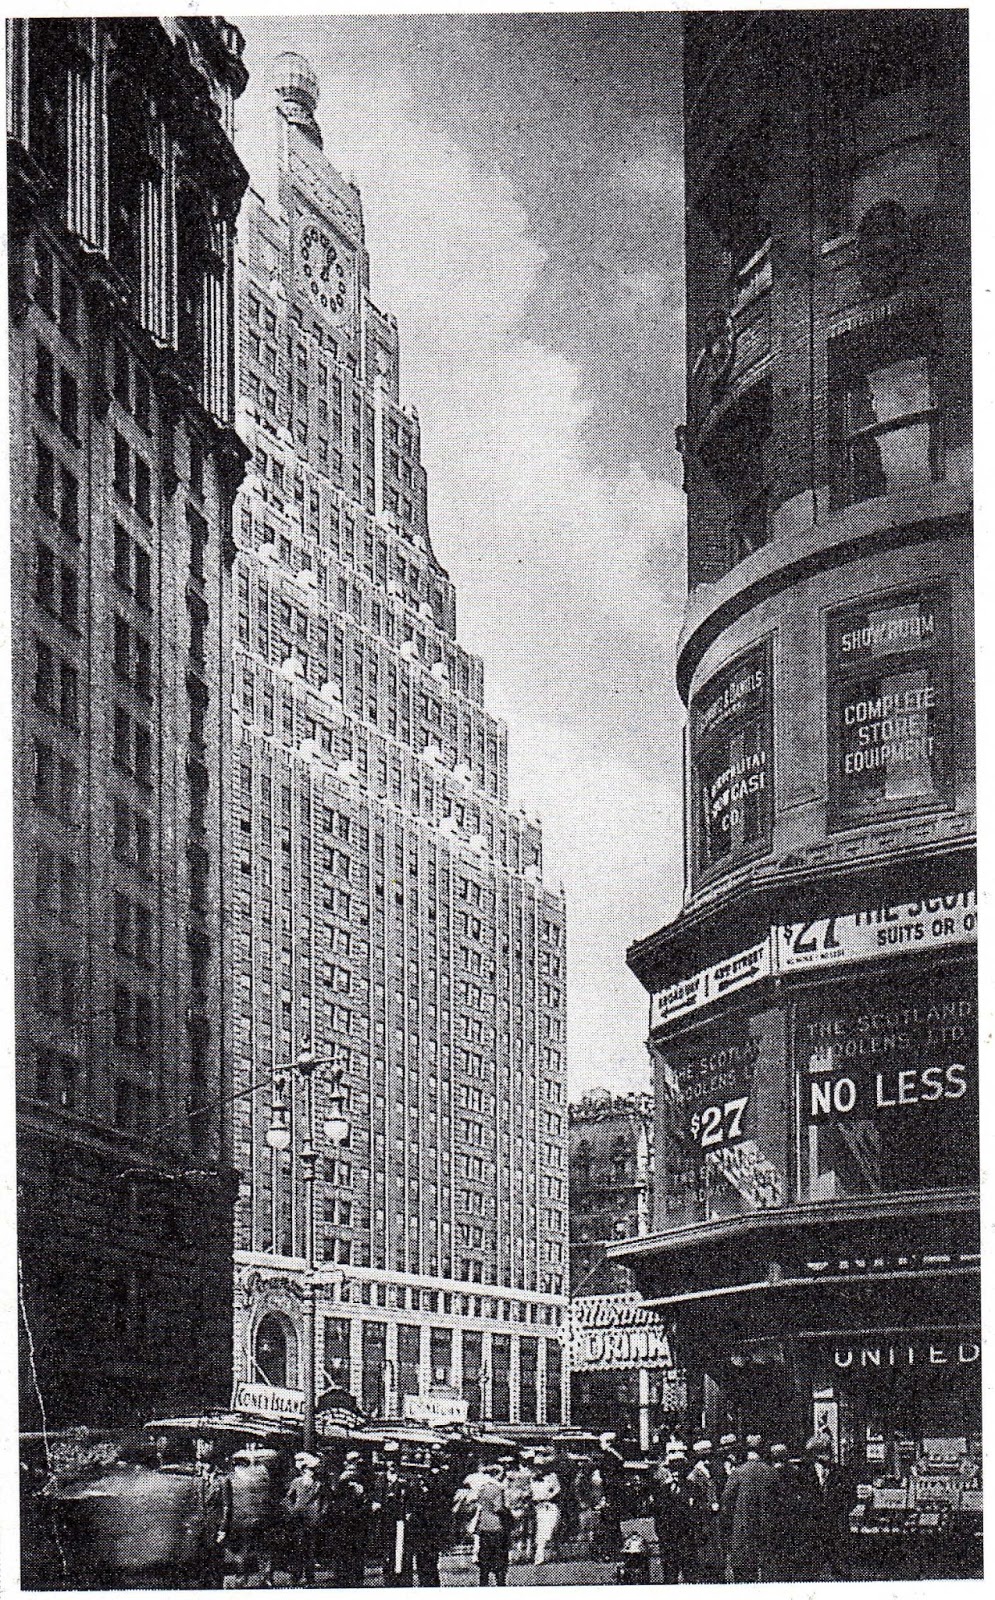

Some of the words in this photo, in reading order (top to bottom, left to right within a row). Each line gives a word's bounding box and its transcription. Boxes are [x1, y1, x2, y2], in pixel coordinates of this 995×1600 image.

[842, 614, 934, 652] SHOWROOM
[844, 687, 935, 725] COMPLETE
[858, 714, 920, 746] STORE
[845, 737, 934, 774] EQUIPMENT
[908, 892, 978, 917] SCOT
[877, 923, 924, 946] SUITS
[932, 917, 955, 937] OR
[963, 912, 978, 931] O
[732, 947, 764, 973] STREET
[807, 1019, 845, 1037] THE
[857, 1001, 972, 1033] SCOTLAND
[811, 1077, 857, 1116] NO
[876, 1063, 968, 1108] LESS
[690, 1097, 748, 1147] $27
[835, 1343, 980, 1367] UNITED
[238, 1387, 269, 1410] CONEY
